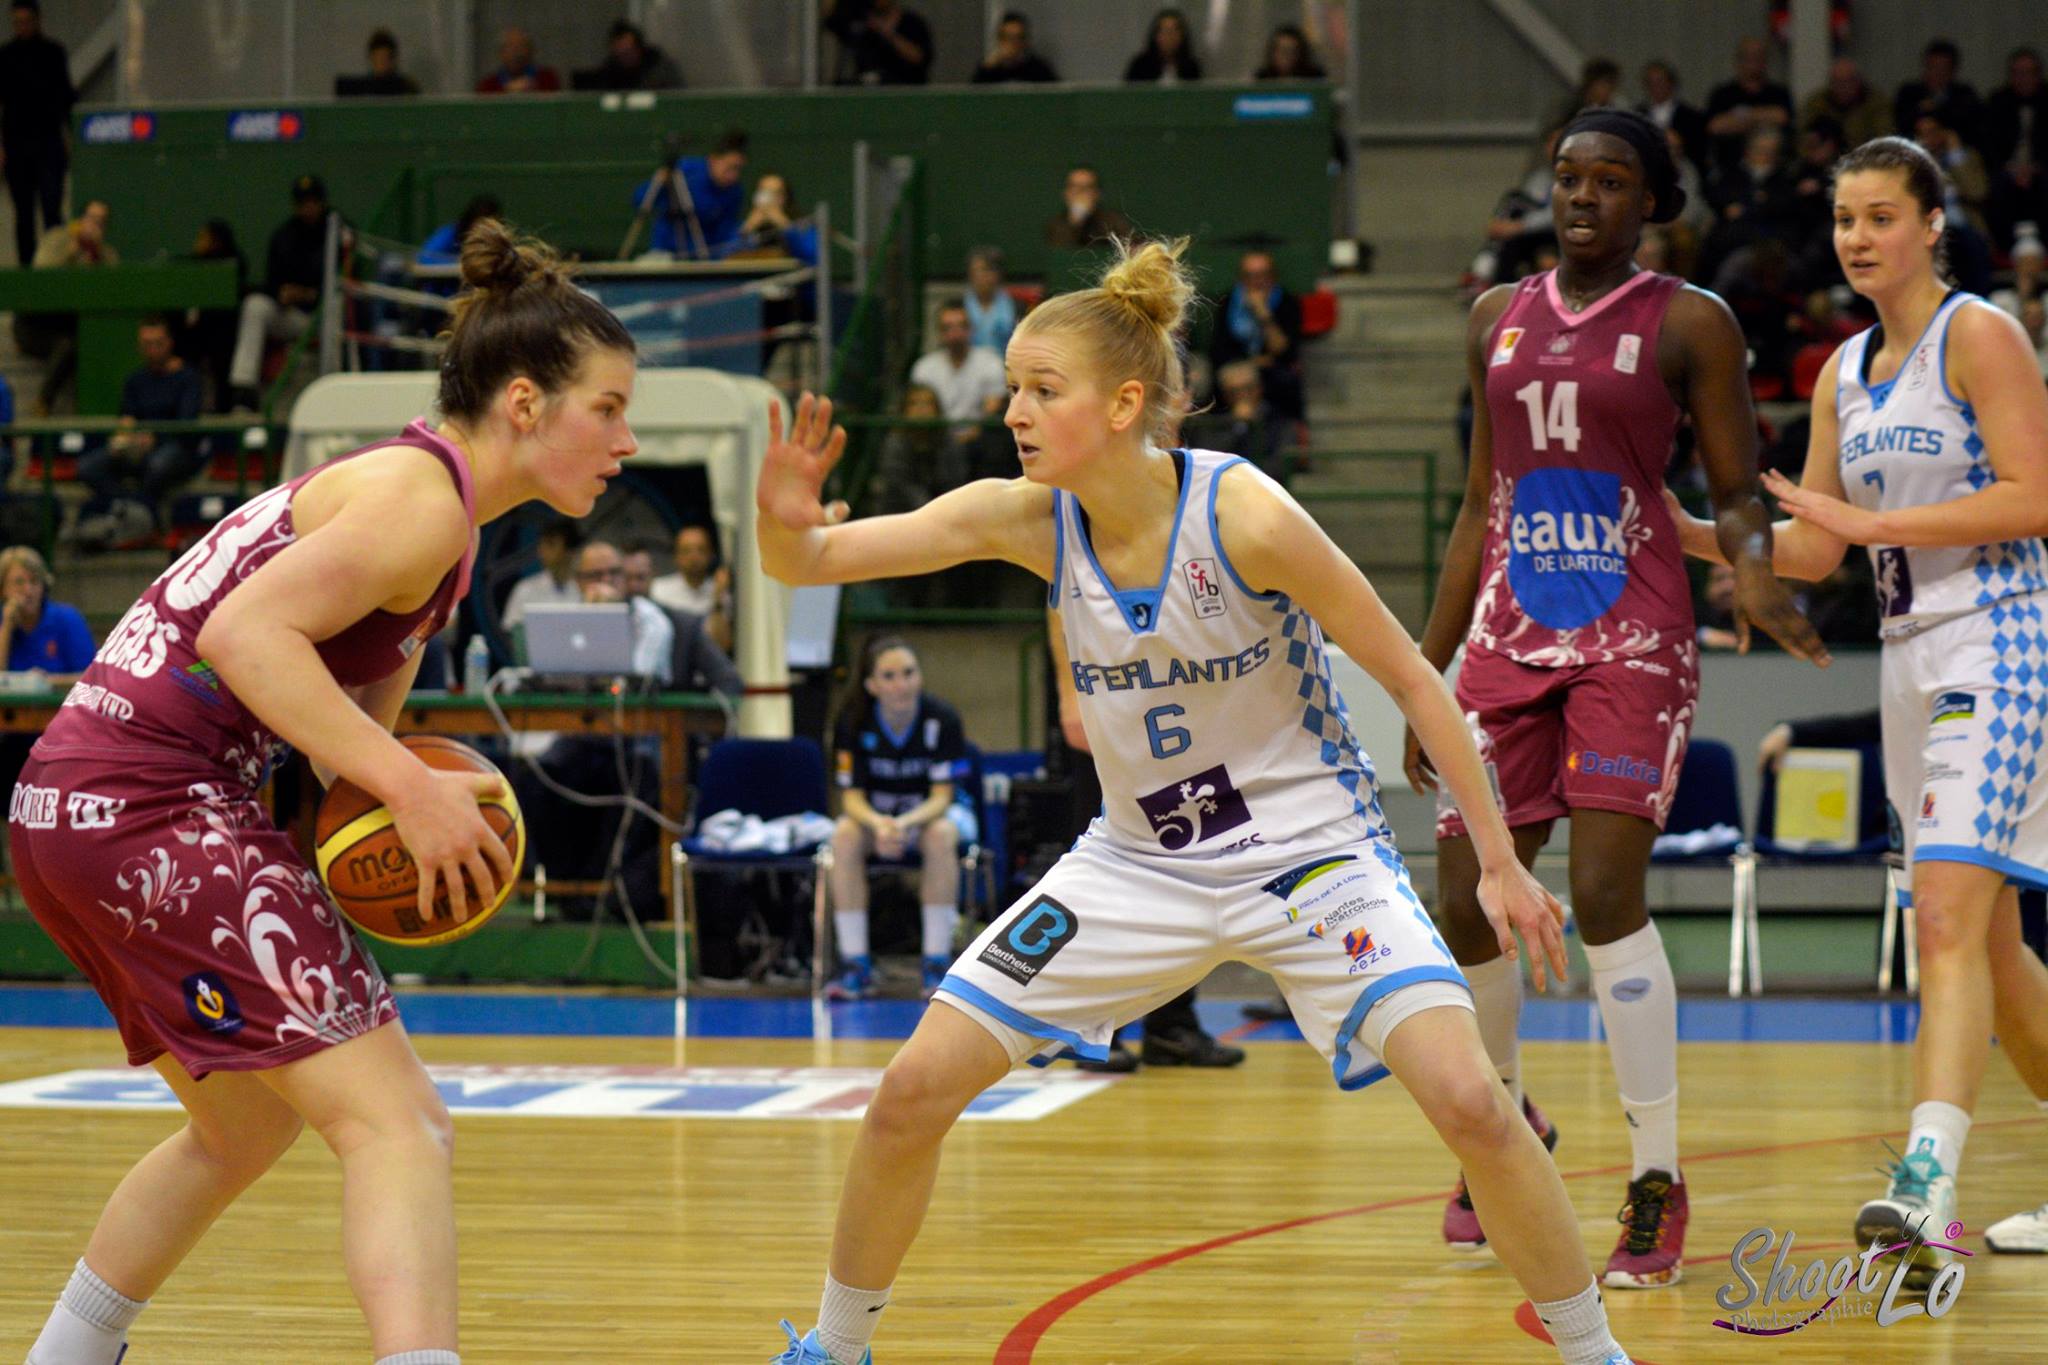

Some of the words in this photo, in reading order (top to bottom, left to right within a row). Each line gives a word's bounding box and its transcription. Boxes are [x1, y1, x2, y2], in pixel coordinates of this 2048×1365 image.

[1515, 380, 1581, 452] 14
[1512, 510, 1627, 556] eaux
[1534, 555, 1556, 573] DE
[1144, 703, 1192, 760] 6
[1582, 750, 1661, 785] Dalkia
[1324, 896, 1364, 920] Nantes
[986, 943, 1037, 975] Berthelot
